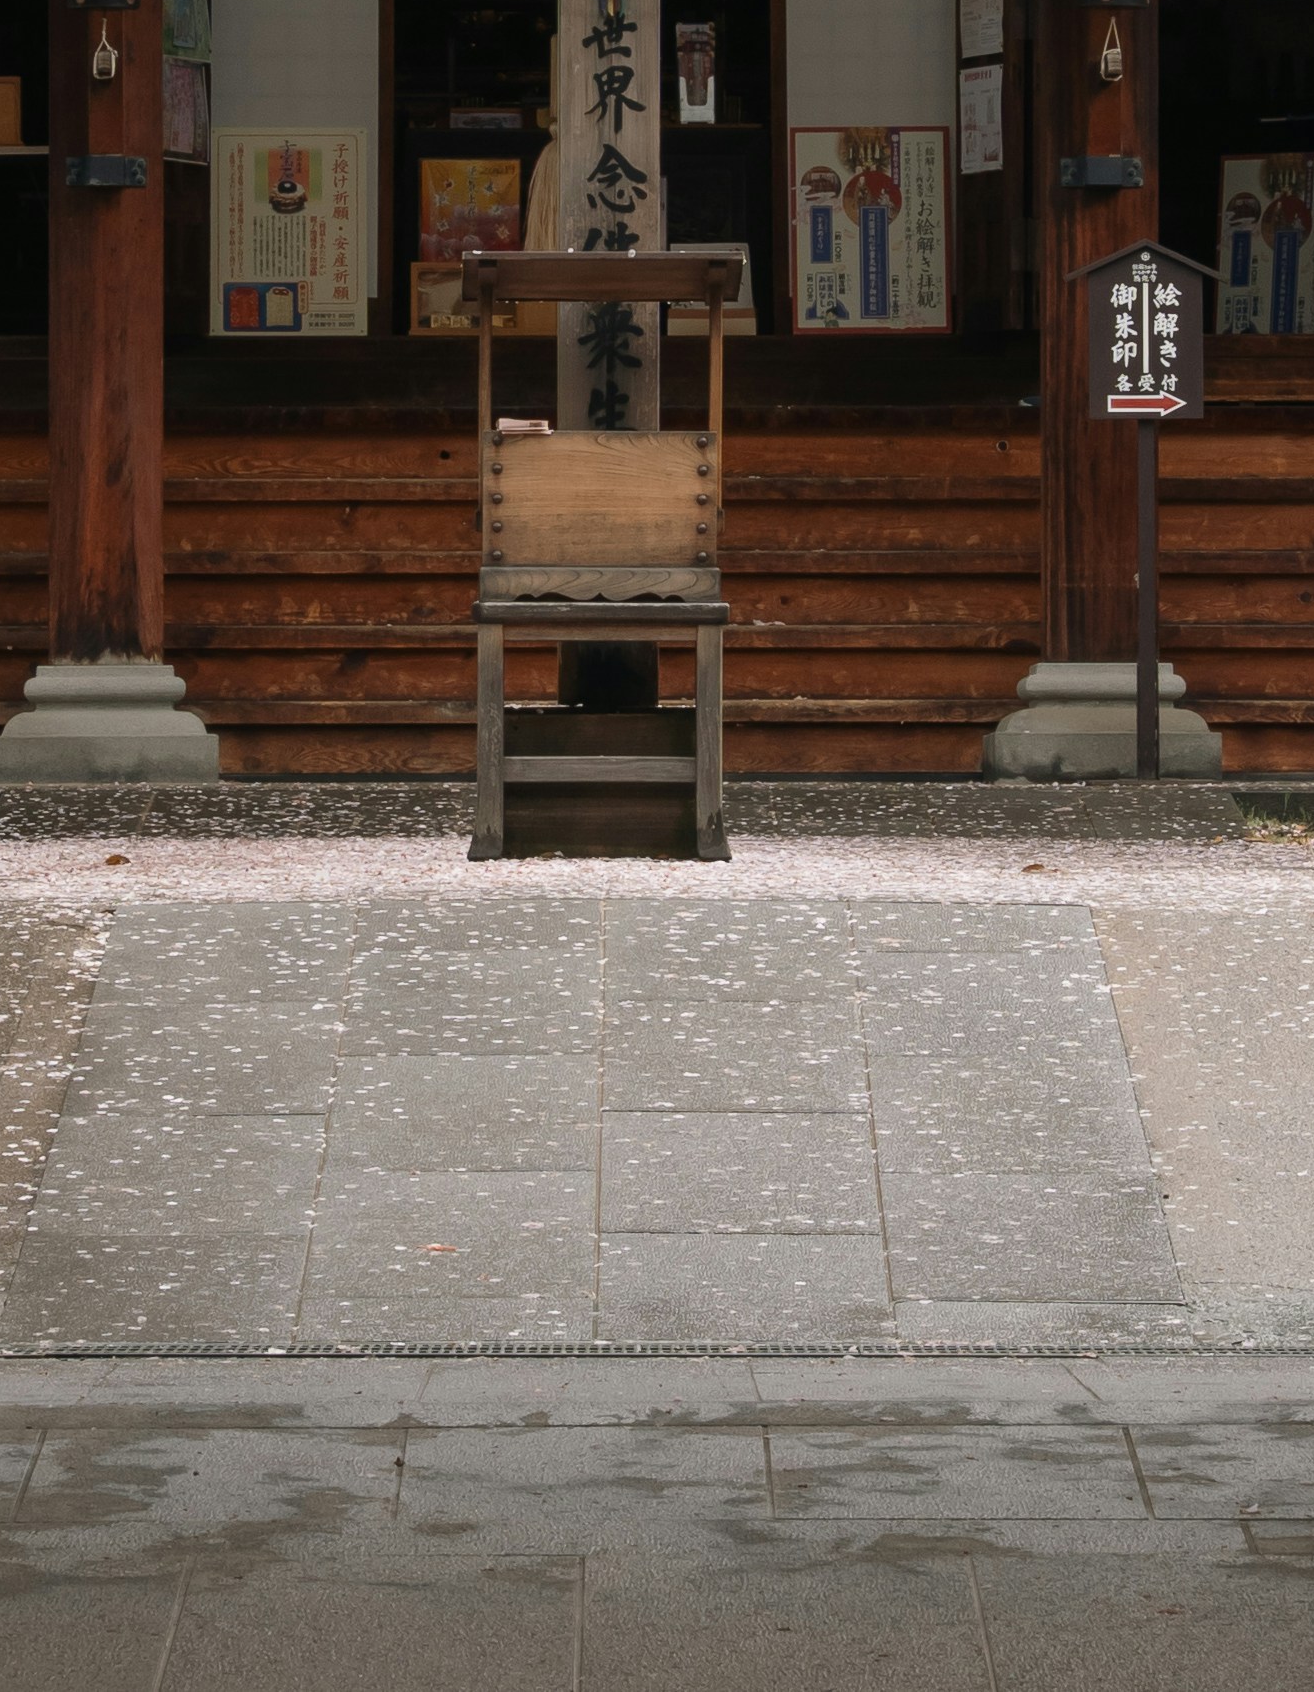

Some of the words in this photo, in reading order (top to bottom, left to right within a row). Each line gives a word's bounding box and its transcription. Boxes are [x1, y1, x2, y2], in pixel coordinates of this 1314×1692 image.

[331, 143, 351, 301] 子授け祈願・安産祈願
[915, 199, 937, 309] お絵解き拝観
[1110, 283, 1138, 368] 御朱印
[1153, 282, 1183, 368] 絵解き
[1115, 374, 1179, 392] 各受付
